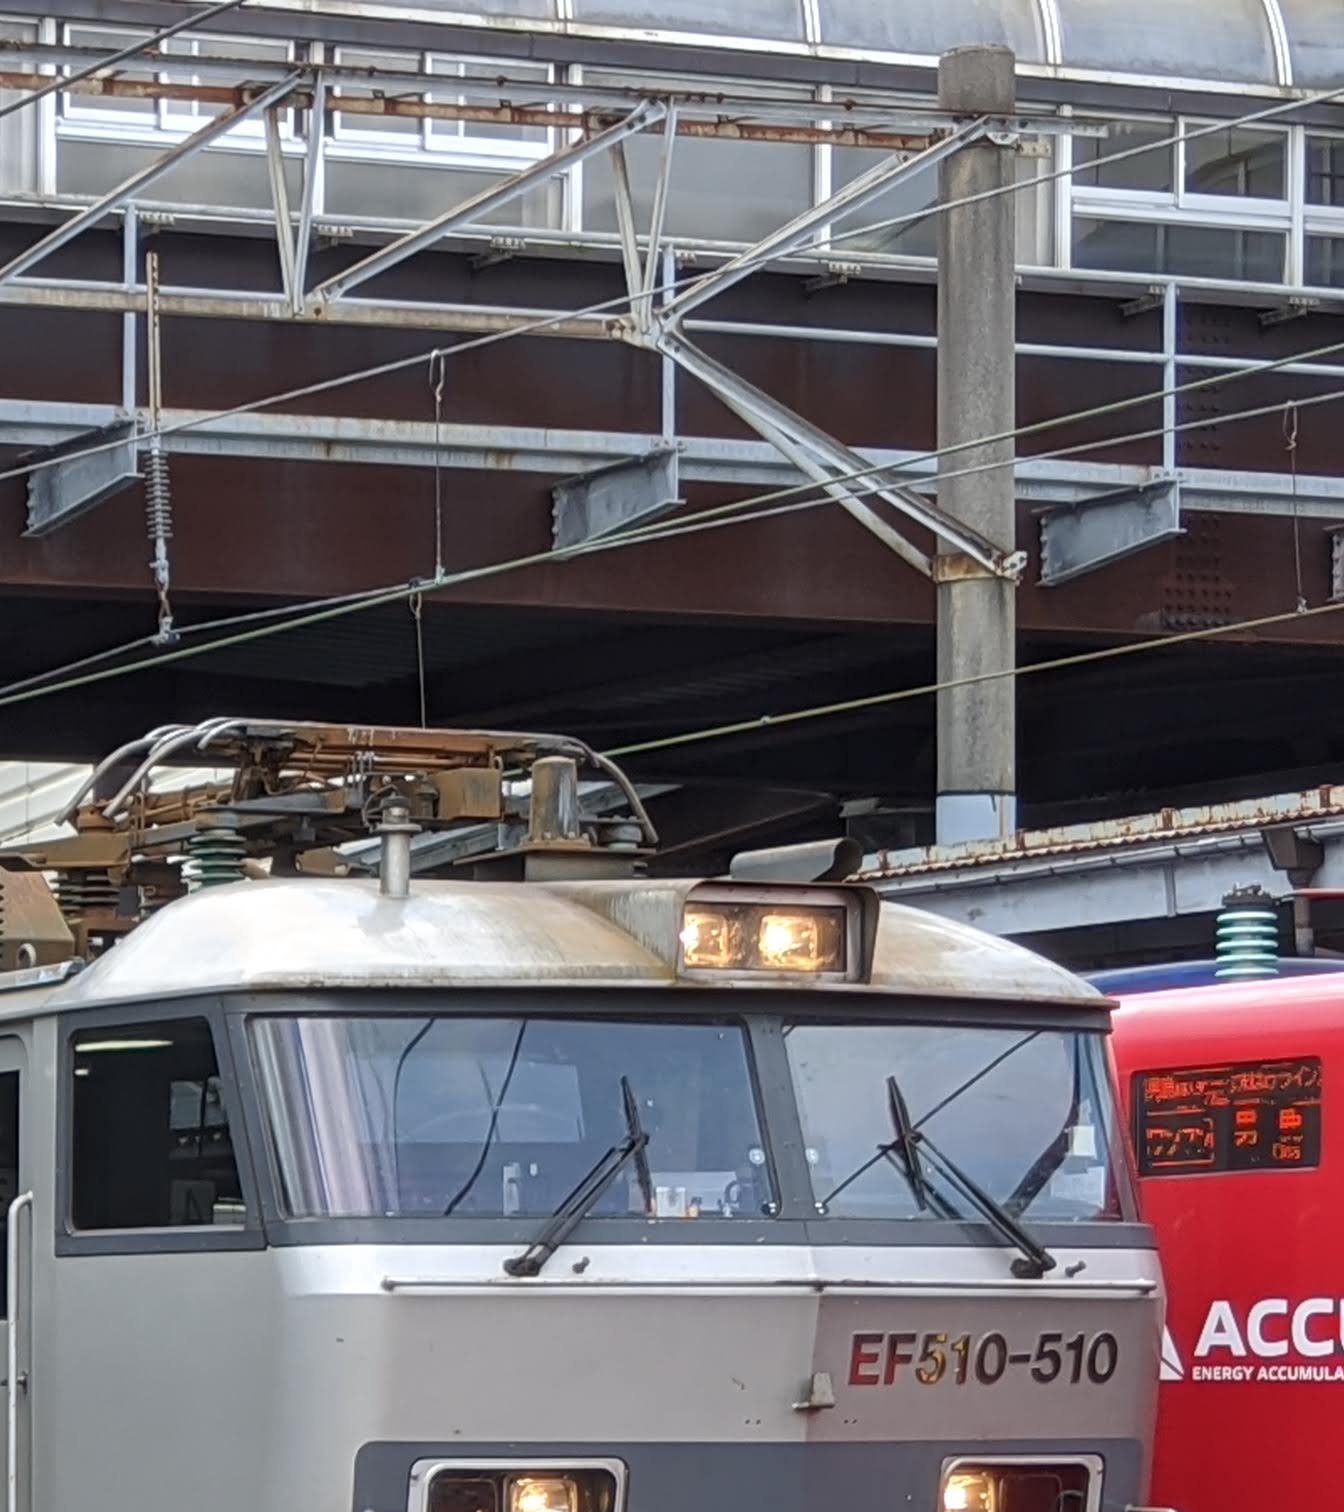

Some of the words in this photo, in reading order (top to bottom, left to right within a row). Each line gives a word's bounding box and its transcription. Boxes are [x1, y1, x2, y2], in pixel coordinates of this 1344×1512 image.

[1193, 1298, 1344, 1357] ACC
[847, 1331, 1118, 1386] EF510-510
[1192, 1366, 1254, 1381] ENERGY
